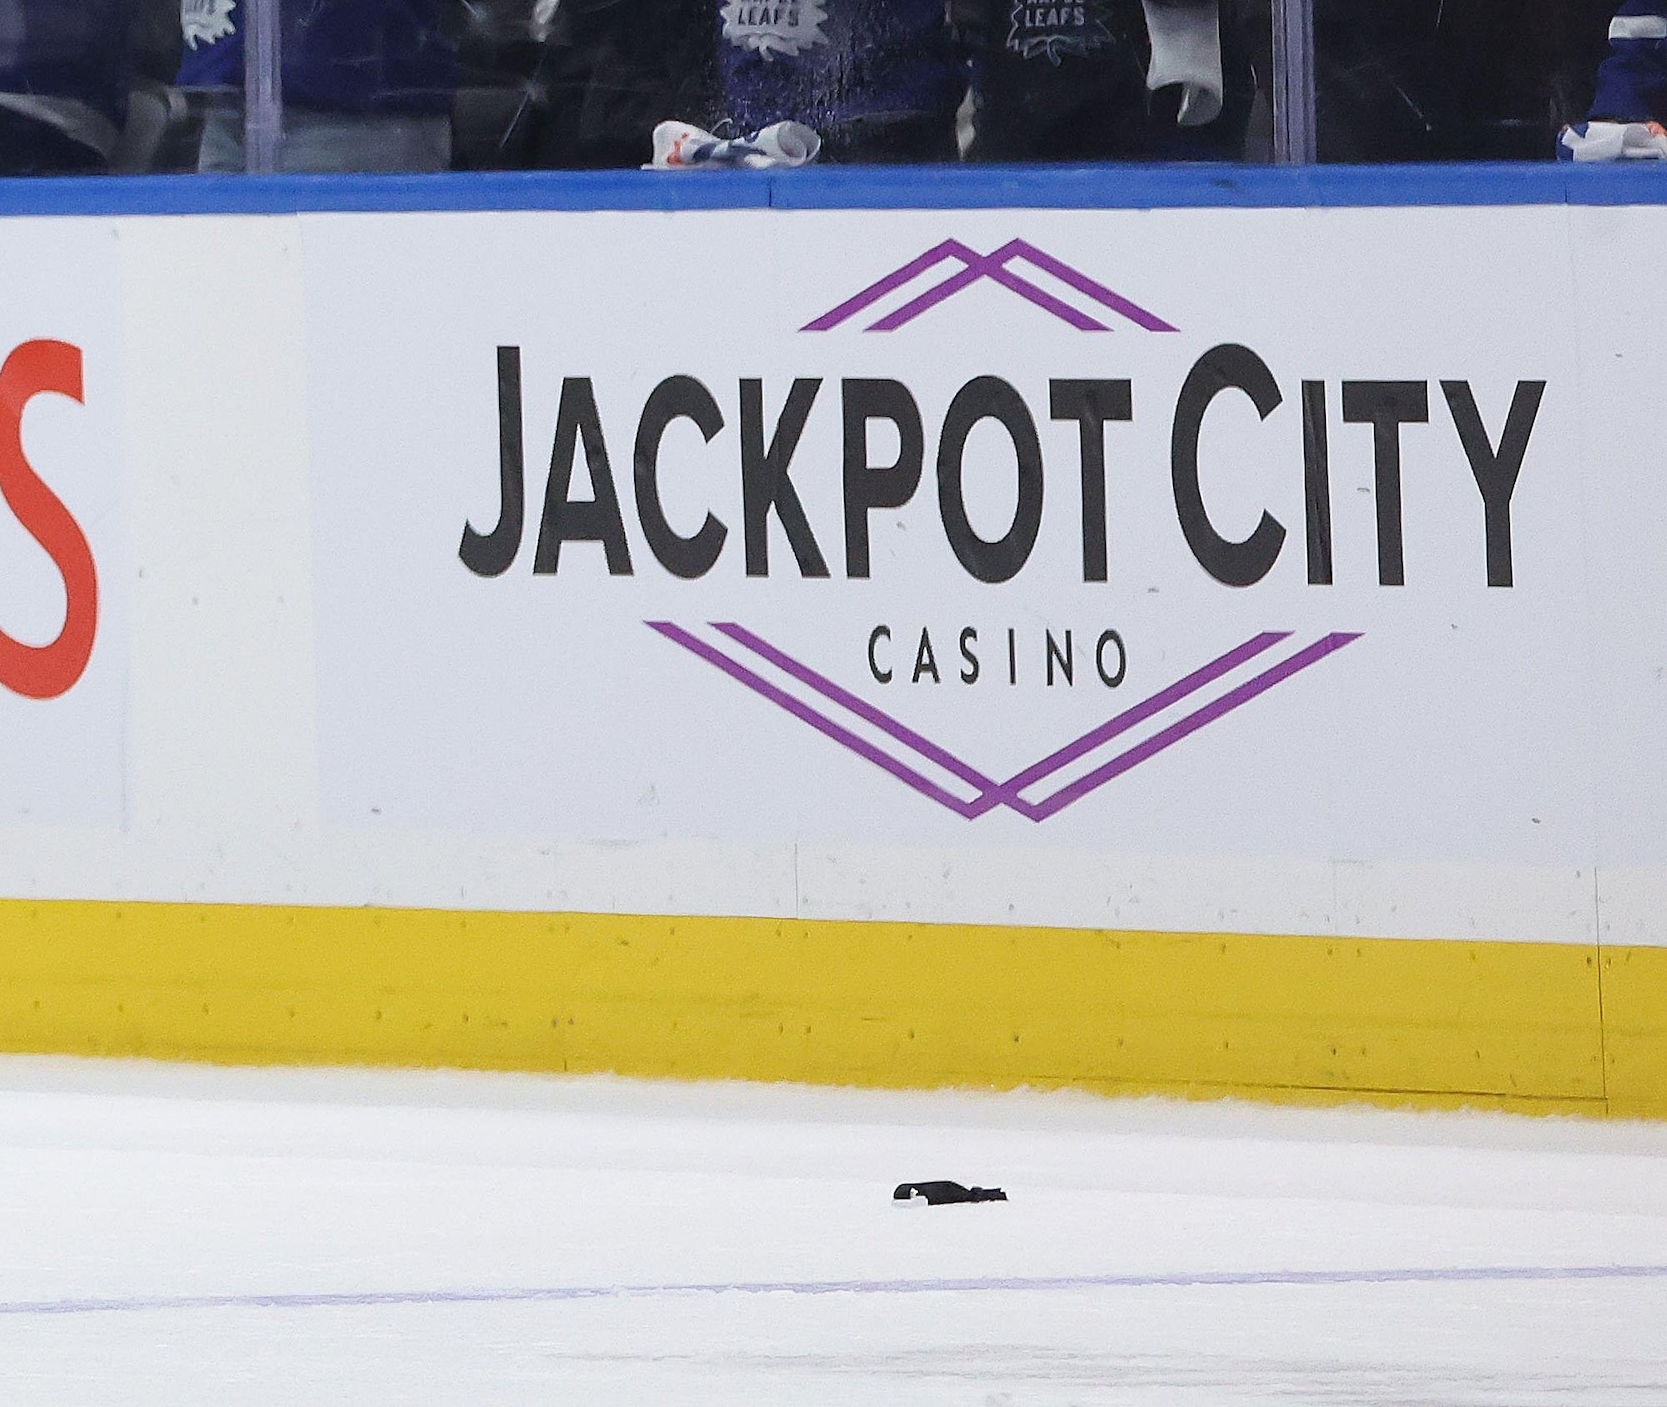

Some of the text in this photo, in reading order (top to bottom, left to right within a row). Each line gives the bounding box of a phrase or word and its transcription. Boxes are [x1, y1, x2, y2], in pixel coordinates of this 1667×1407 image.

[738, 7, 799, 27] LEAFS
[1025, 7, 1085, 27] LEAFS
[457, 342, 1548, 588] JACKPOT CITY
[867, 624, 1130, 690] CASINO
